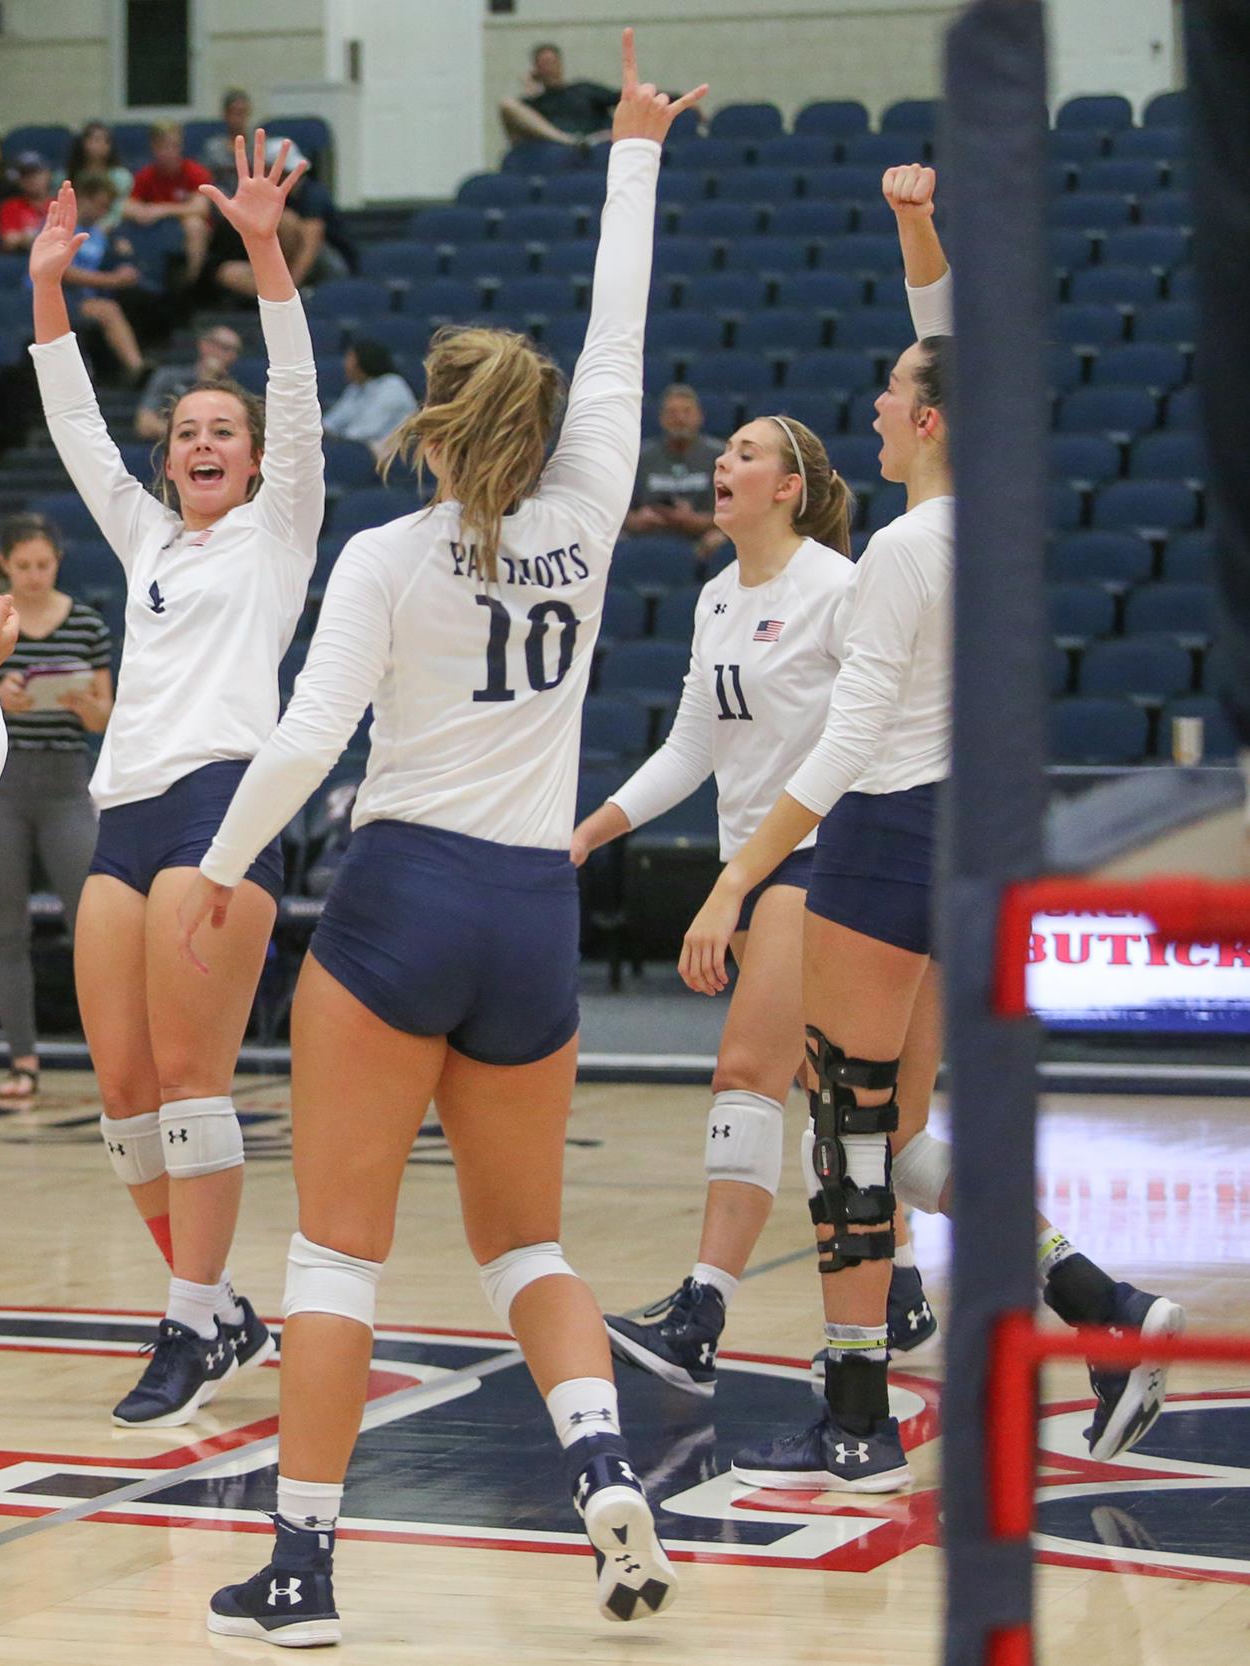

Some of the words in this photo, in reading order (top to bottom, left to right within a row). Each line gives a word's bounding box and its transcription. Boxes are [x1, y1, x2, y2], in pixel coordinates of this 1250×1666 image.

[450, 542, 589, 588] PAIOTS
[473, 594, 581, 702] 10
[714, 664, 753, 721] 11
